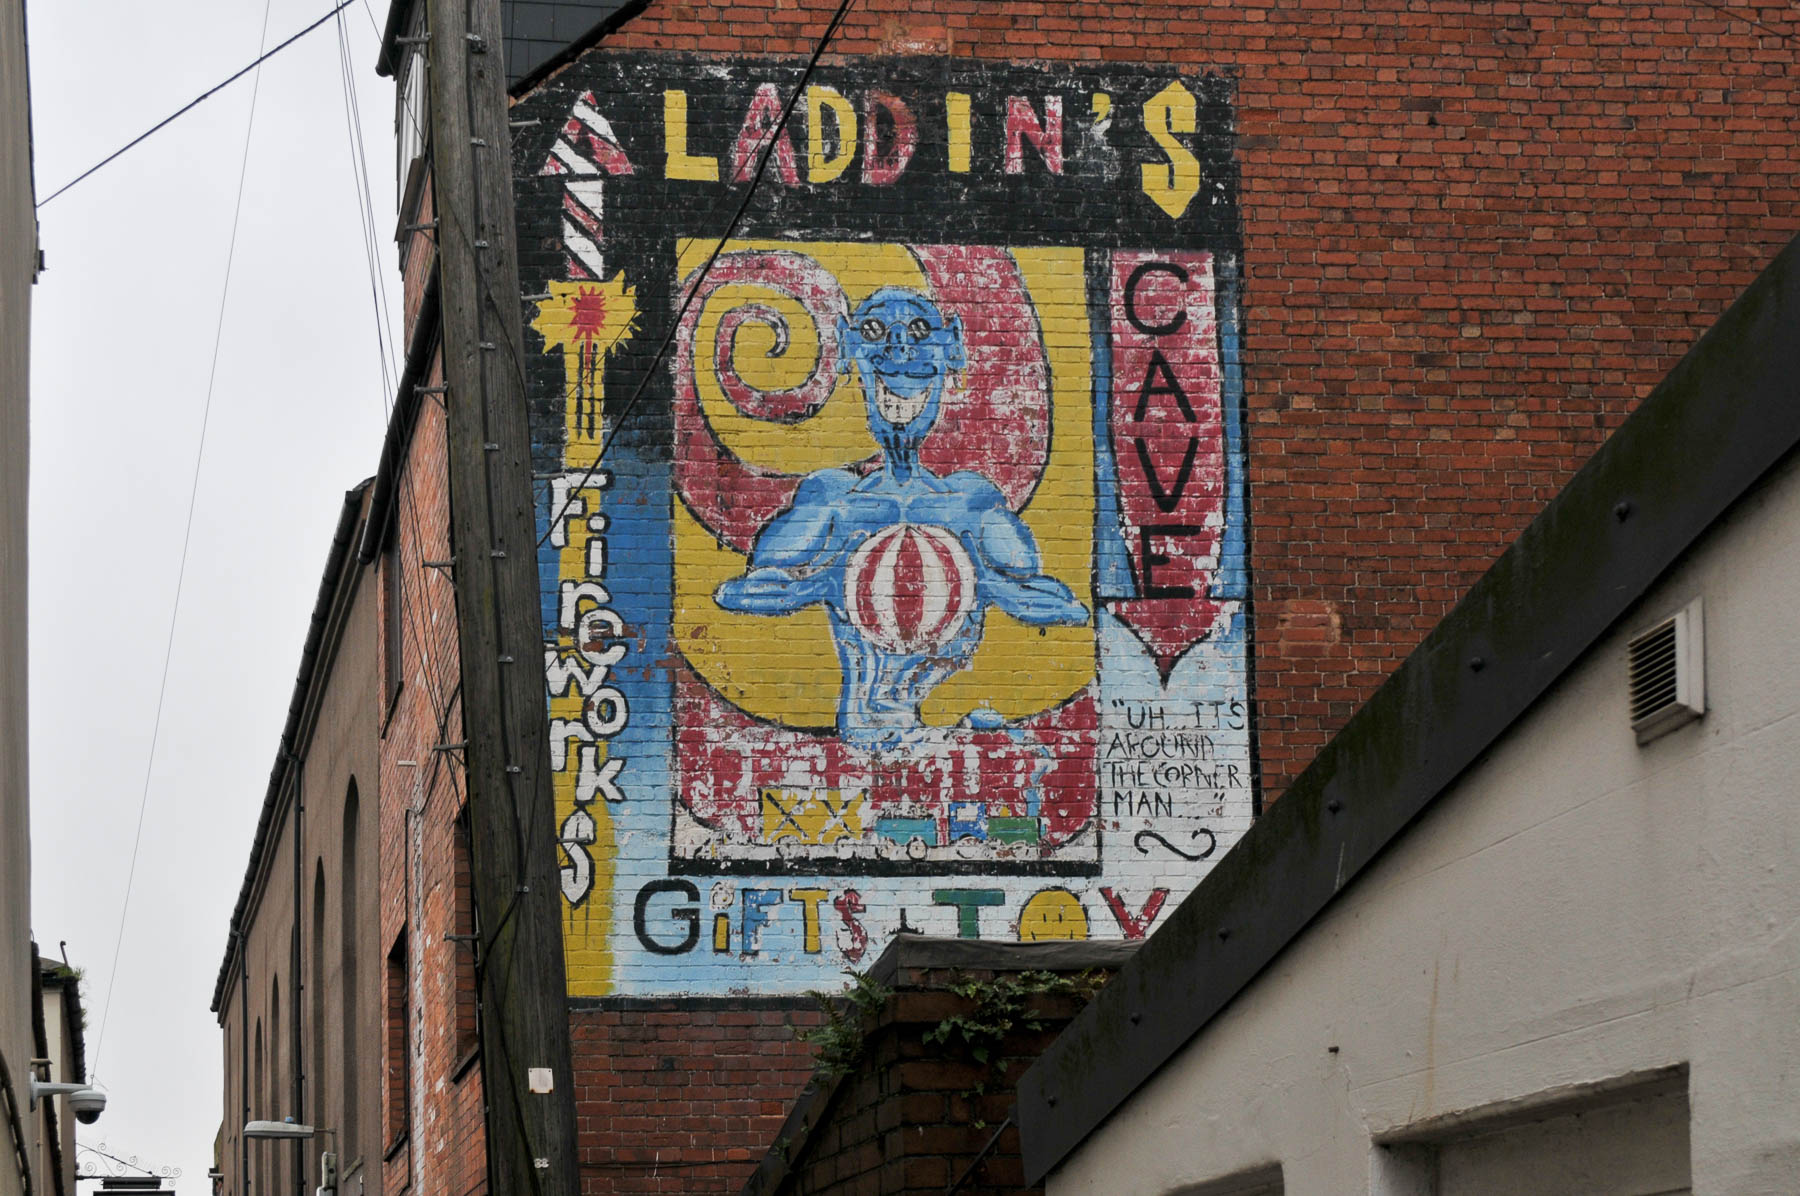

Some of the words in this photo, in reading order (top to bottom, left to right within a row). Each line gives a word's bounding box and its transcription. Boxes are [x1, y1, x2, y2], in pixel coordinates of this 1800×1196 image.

[1124, 262, 1201, 600] CAVE
[1105, 732, 1215, 761] AROUND
[1103, 761, 1150, 788] THE
[1152, 762, 1243, 789] CORNER
